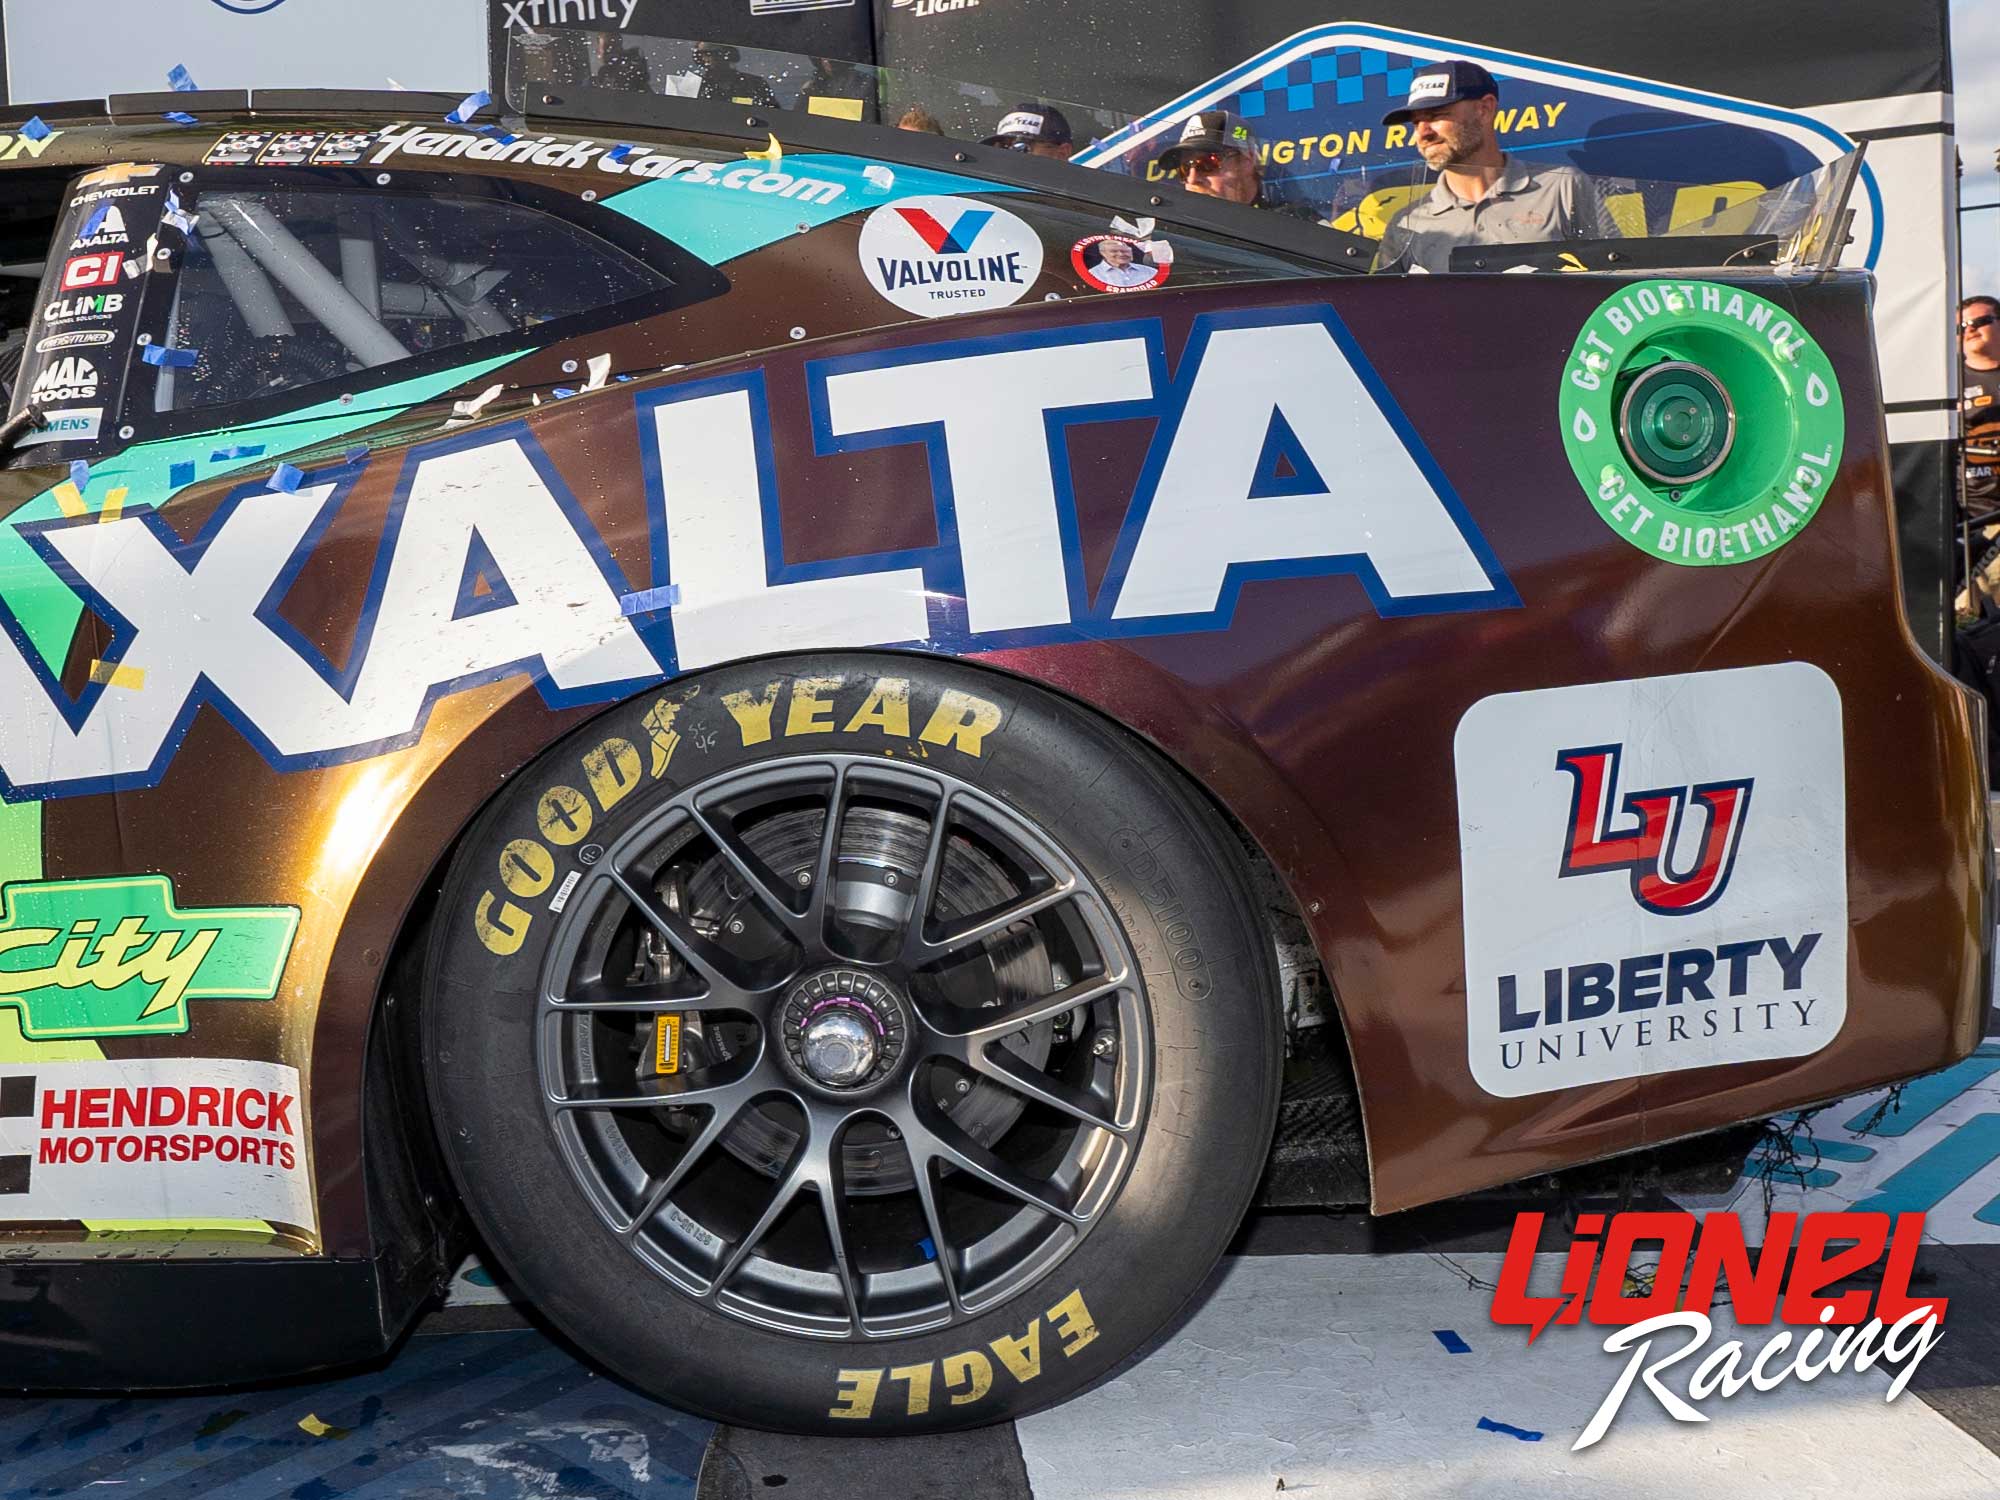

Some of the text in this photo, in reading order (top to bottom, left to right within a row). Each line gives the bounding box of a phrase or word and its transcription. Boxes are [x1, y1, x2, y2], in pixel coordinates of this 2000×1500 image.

[502, 0, 637, 34] xfinity
[1232, 126, 1248, 141] 24
[70, 185, 160, 208] CHEVROLET
[70, 232, 130, 251] AXALTA
[64, 255, 120, 288] CI
[877, 251, 1024, 291] VALVOLINE
[43, 293, 124, 322] CLIMB
[928, 288, 987, 300] TRUSTED
[1604, 285, 1806, 362] BIOETHANOL
[31, 356, 99, 394] MAC
[1570, 330, 1615, 392] GET
[30, 386, 97, 405] TOOLS
[1598, 473, 1655, 535] GET
[1657, 451, 1832, 559] BIOETHANOL
[1555, 743, 1755, 916] LU
[0, 916, 223, 1020] City
[1497, 932, 1823, 1033] LIBERTY
[1500, 998, 1818, 1070] UNIVERSITY
[41, 1086, 295, 1136] HENDRICK
[38, 1134, 296, 1170] MOTORSPORTS
[828, 1288, 1100, 1419] EAGLE
